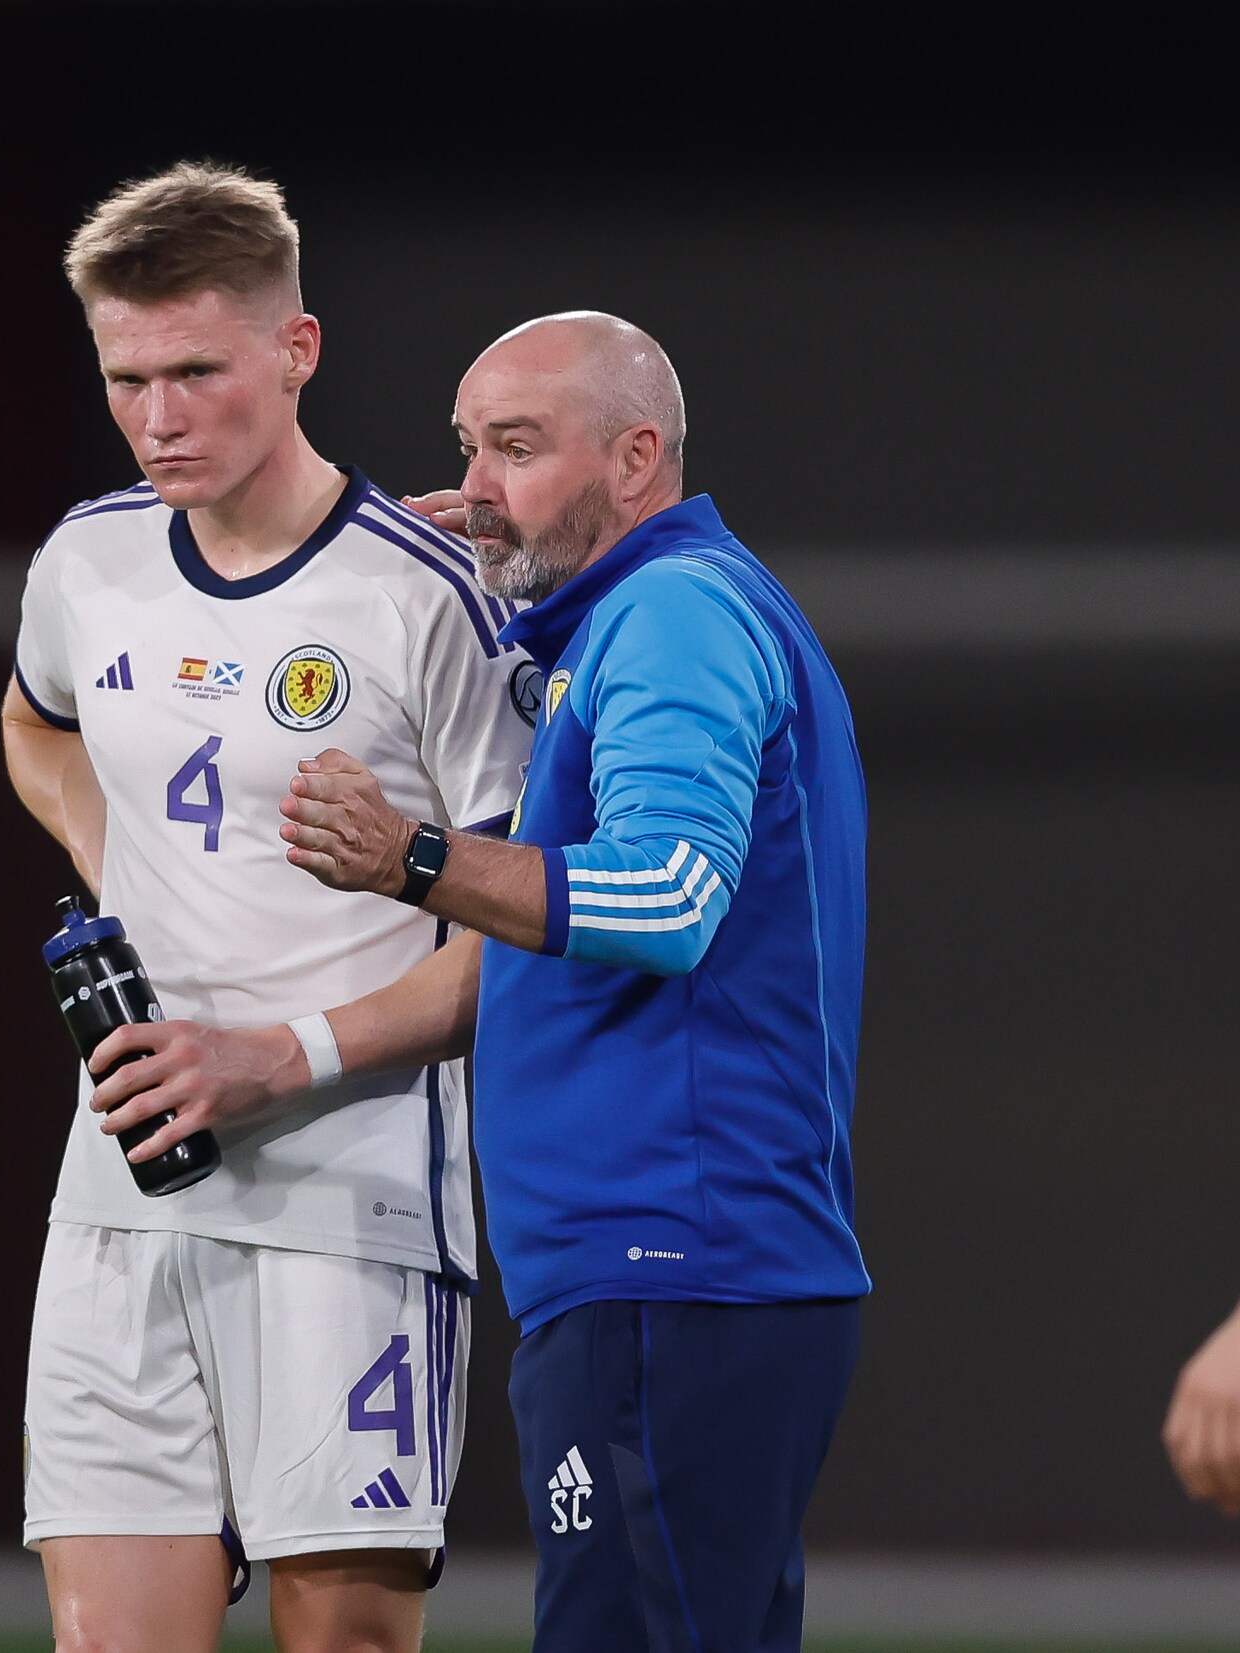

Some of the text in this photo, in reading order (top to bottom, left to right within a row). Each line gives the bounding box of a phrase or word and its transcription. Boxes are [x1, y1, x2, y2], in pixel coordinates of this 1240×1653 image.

[294, 650, 331, 661] SCOTLAND
[167, 735, 223, 852] 4
[644, 1250, 685, 1260] AEROREADY
[348, 1334, 416, 1457] 4
[551, 1485, 593, 1534] SC
